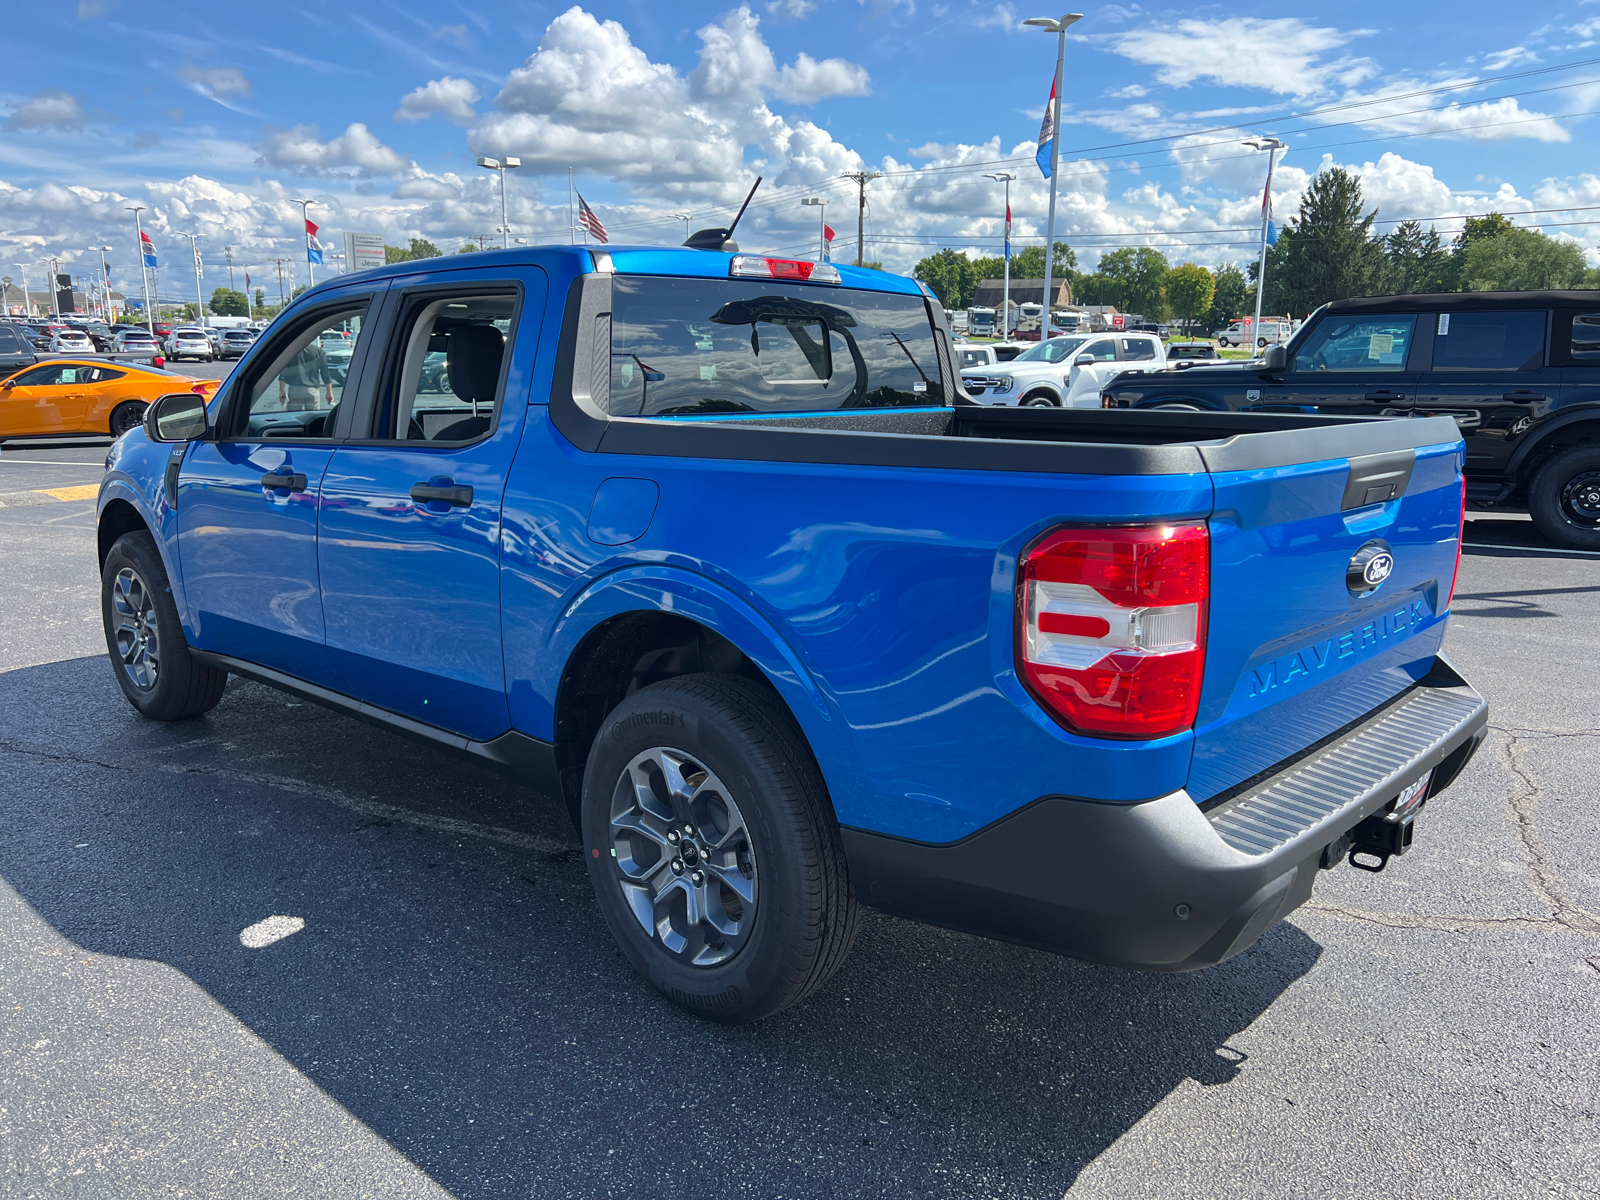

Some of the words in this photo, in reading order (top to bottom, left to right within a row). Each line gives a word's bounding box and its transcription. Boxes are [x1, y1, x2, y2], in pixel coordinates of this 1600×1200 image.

[361, 259, 380, 268] Jeep
[1369, 558, 1389, 581] Ford
[1248, 600, 1423, 698] MAVERICK
[612, 709, 676, 739] Continental
[670, 984, 743, 1011] Continental
